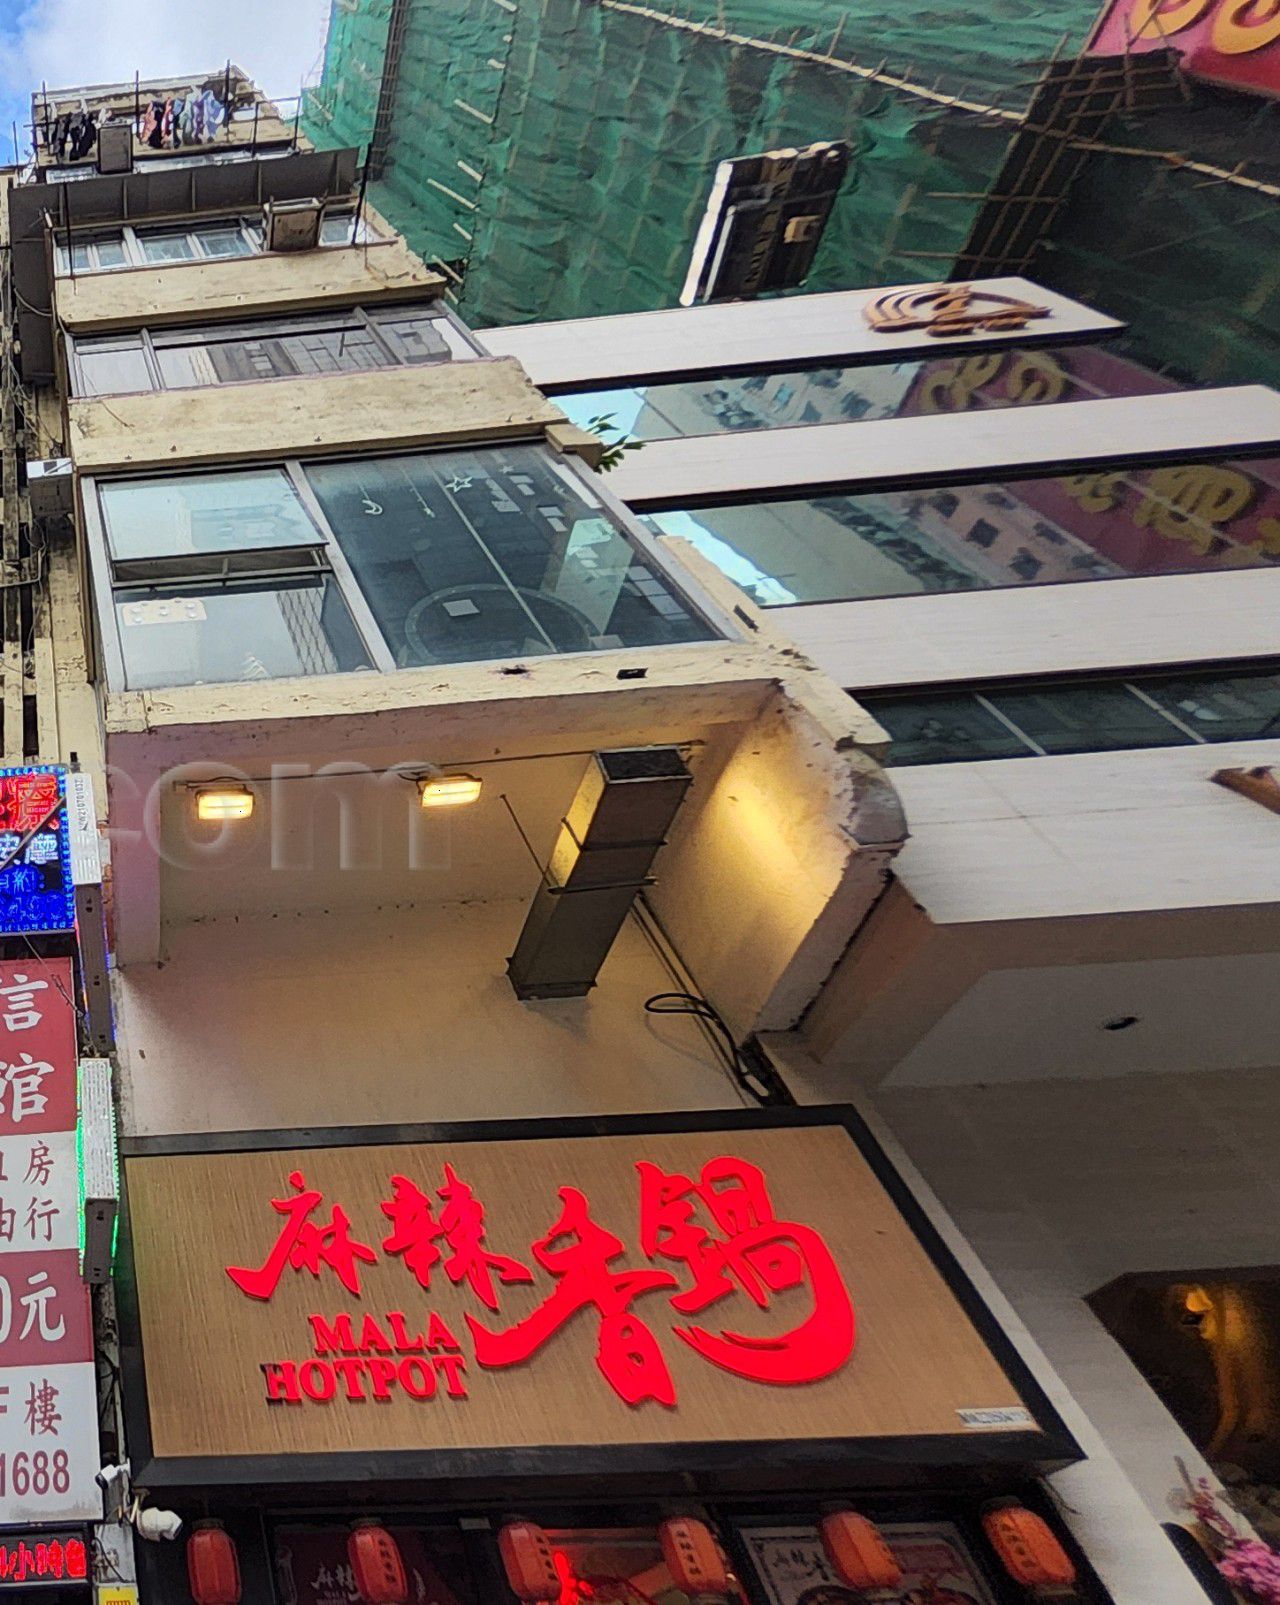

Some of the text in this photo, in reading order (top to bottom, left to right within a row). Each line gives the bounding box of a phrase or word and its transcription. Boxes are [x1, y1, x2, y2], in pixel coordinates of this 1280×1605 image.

[226, 1154, 856, 1408] 麻辣香鍋
[308, 1312, 461, 1354] MALA
[261, 1354, 469, 1405] HOTPOT
